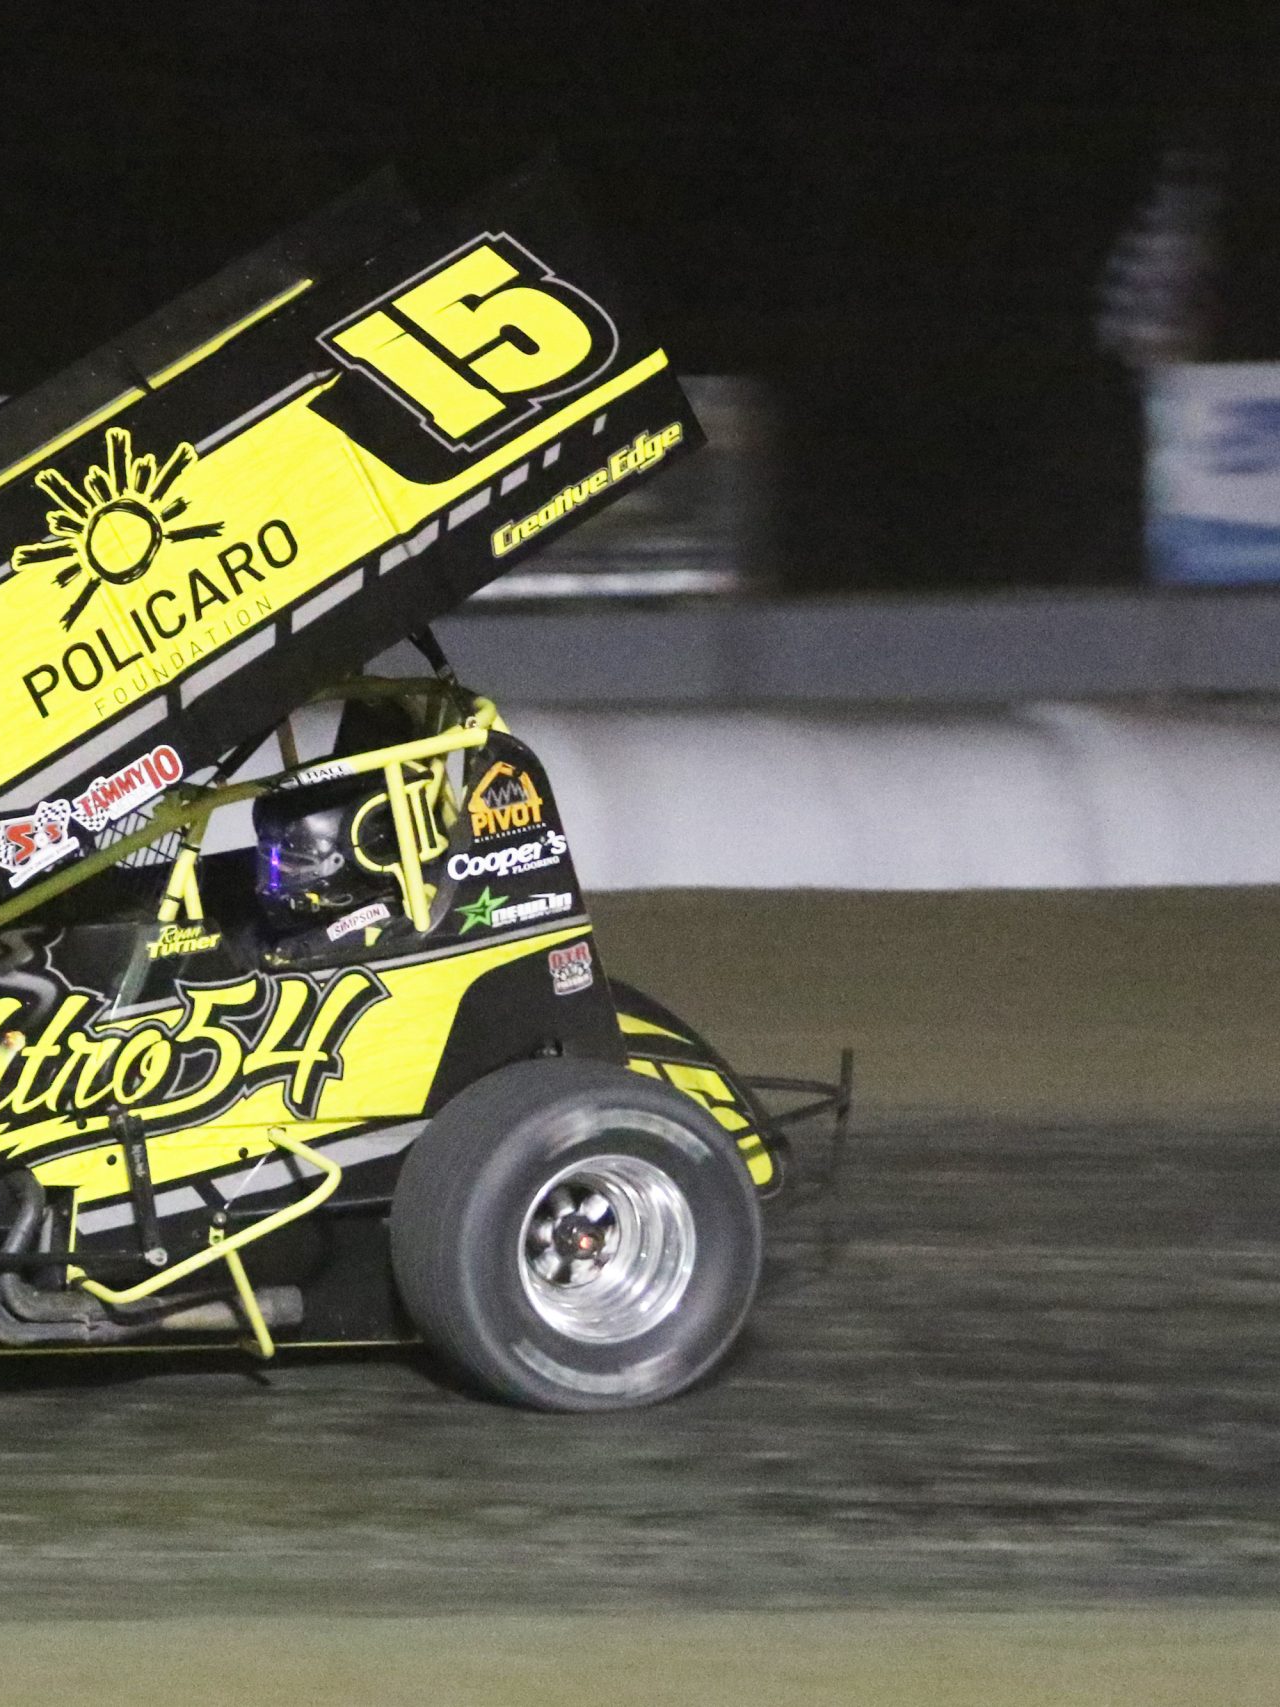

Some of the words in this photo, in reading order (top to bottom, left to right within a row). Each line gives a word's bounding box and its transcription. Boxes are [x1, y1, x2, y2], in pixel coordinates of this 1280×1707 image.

[328, 242, 598, 442] 15
[491, 485, 610, 557] Creative
[608, 422, 683, 482] Edge
[22, 519, 298, 718] POLICARO
[94, 595, 273, 717] FOUNDATION
[470, 797, 544, 837] PIVOT
[447, 830, 567, 880] Cooper's
[511, 855, 560, 875] FLOORING
[334, 906, 381, 935] SIMPSON
[146, 933, 222, 960] Turner
